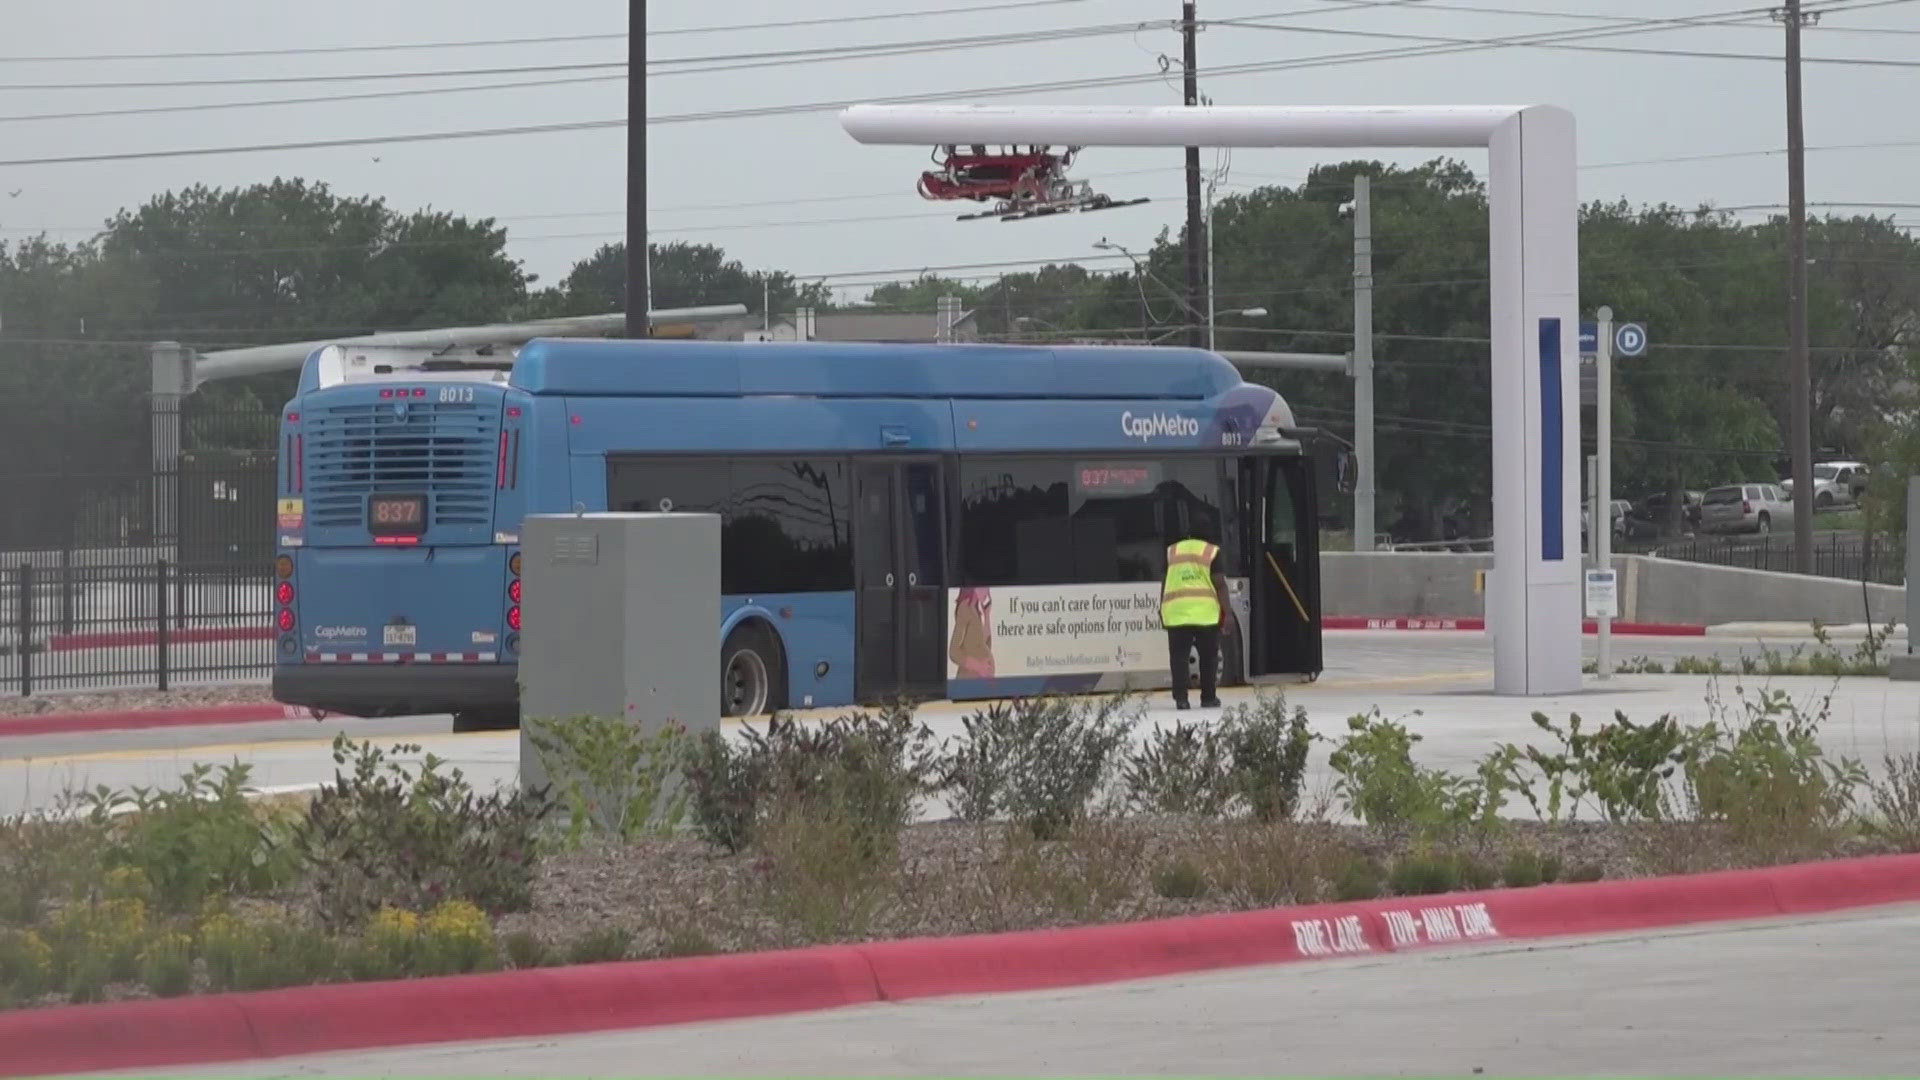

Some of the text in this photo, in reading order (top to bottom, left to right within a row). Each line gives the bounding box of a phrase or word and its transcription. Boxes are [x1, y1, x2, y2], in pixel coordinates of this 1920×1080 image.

[1624, 331, 1639, 348] D
[439, 387, 474, 402] 8013
[1121, 410, 1199, 443] CapMetro
[1221, 432, 1242, 446] 8013
[1081, 469, 1109, 486] 837
[377, 502, 416, 522] 837
[1009, 592, 1159, 617] If you can't care for your baby,
[315, 624, 367, 639] CapMetro
[997, 619, 1025, 636] there
[1027, 622, 1044, 636] are
[1046, 617, 1066, 634] safe
[1067, 617, 1105, 639] options
[1107, 615, 1121, 632] for
[1124, 620, 1143, 637] you
[1291, 919, 1331, 955] FIRE
[1323, 915, 1371, 952] LANE
[1455, 903, 1497, 936] ZONE
